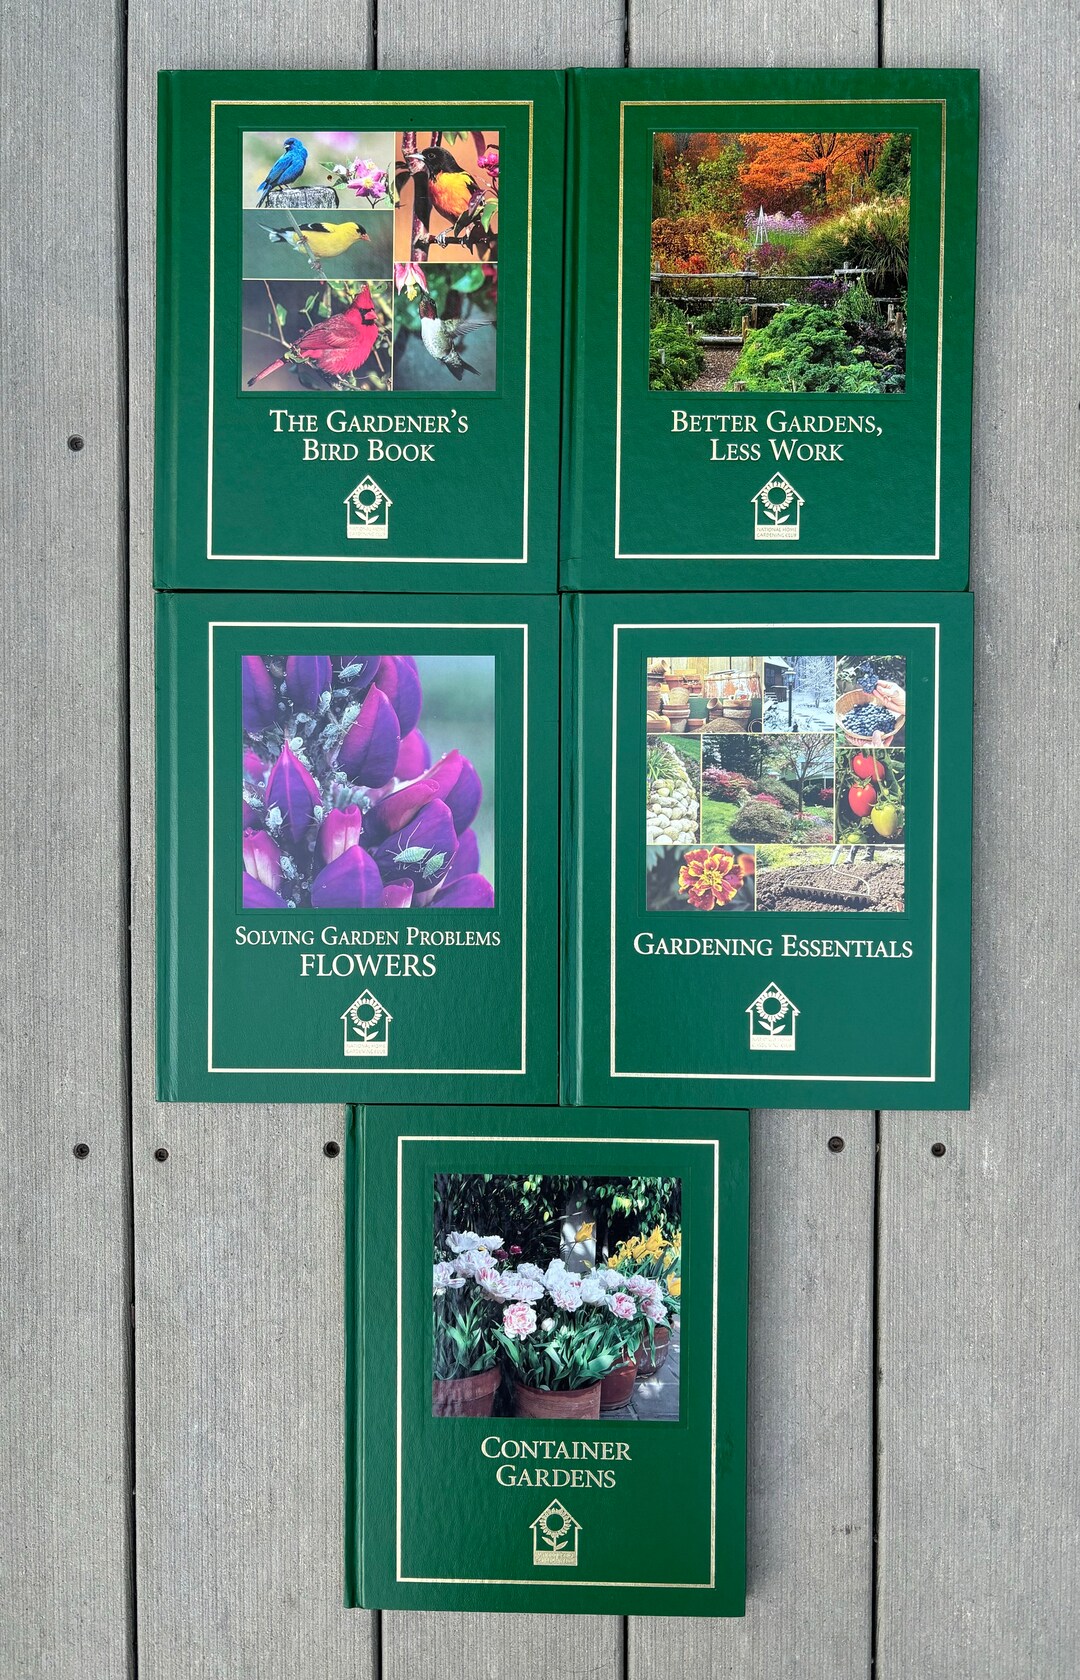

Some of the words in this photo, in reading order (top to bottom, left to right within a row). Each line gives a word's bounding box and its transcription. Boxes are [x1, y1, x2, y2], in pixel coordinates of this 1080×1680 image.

[269, 409, 319, 433] THE
[326, 409, 469, 434] GARDENER'S
[670, 410, 759, 433] BETTER
[766, 410, 883, 437] GARDENS,
[302, 438, 359, 461] BIRD
[367, 439, 435, 462] BOOK
[710, 438, 761, 461] LESS
[768, 438, 844, 461] WORK
[235, 925, 315, 946] SOLVING
[321, 926, 400, 946] GARDEN
[405, 926, 501, 947] PROBLEMS
[633, 932, 773, 957] GARDENING
[781, 934, 914, 959] ESSENTIALS
[299, 953, 437, 978] FLOWERS
[480, 1436, 633, 1461] CONTAINER
[495, 1464, 616, 1489] GARDENS
